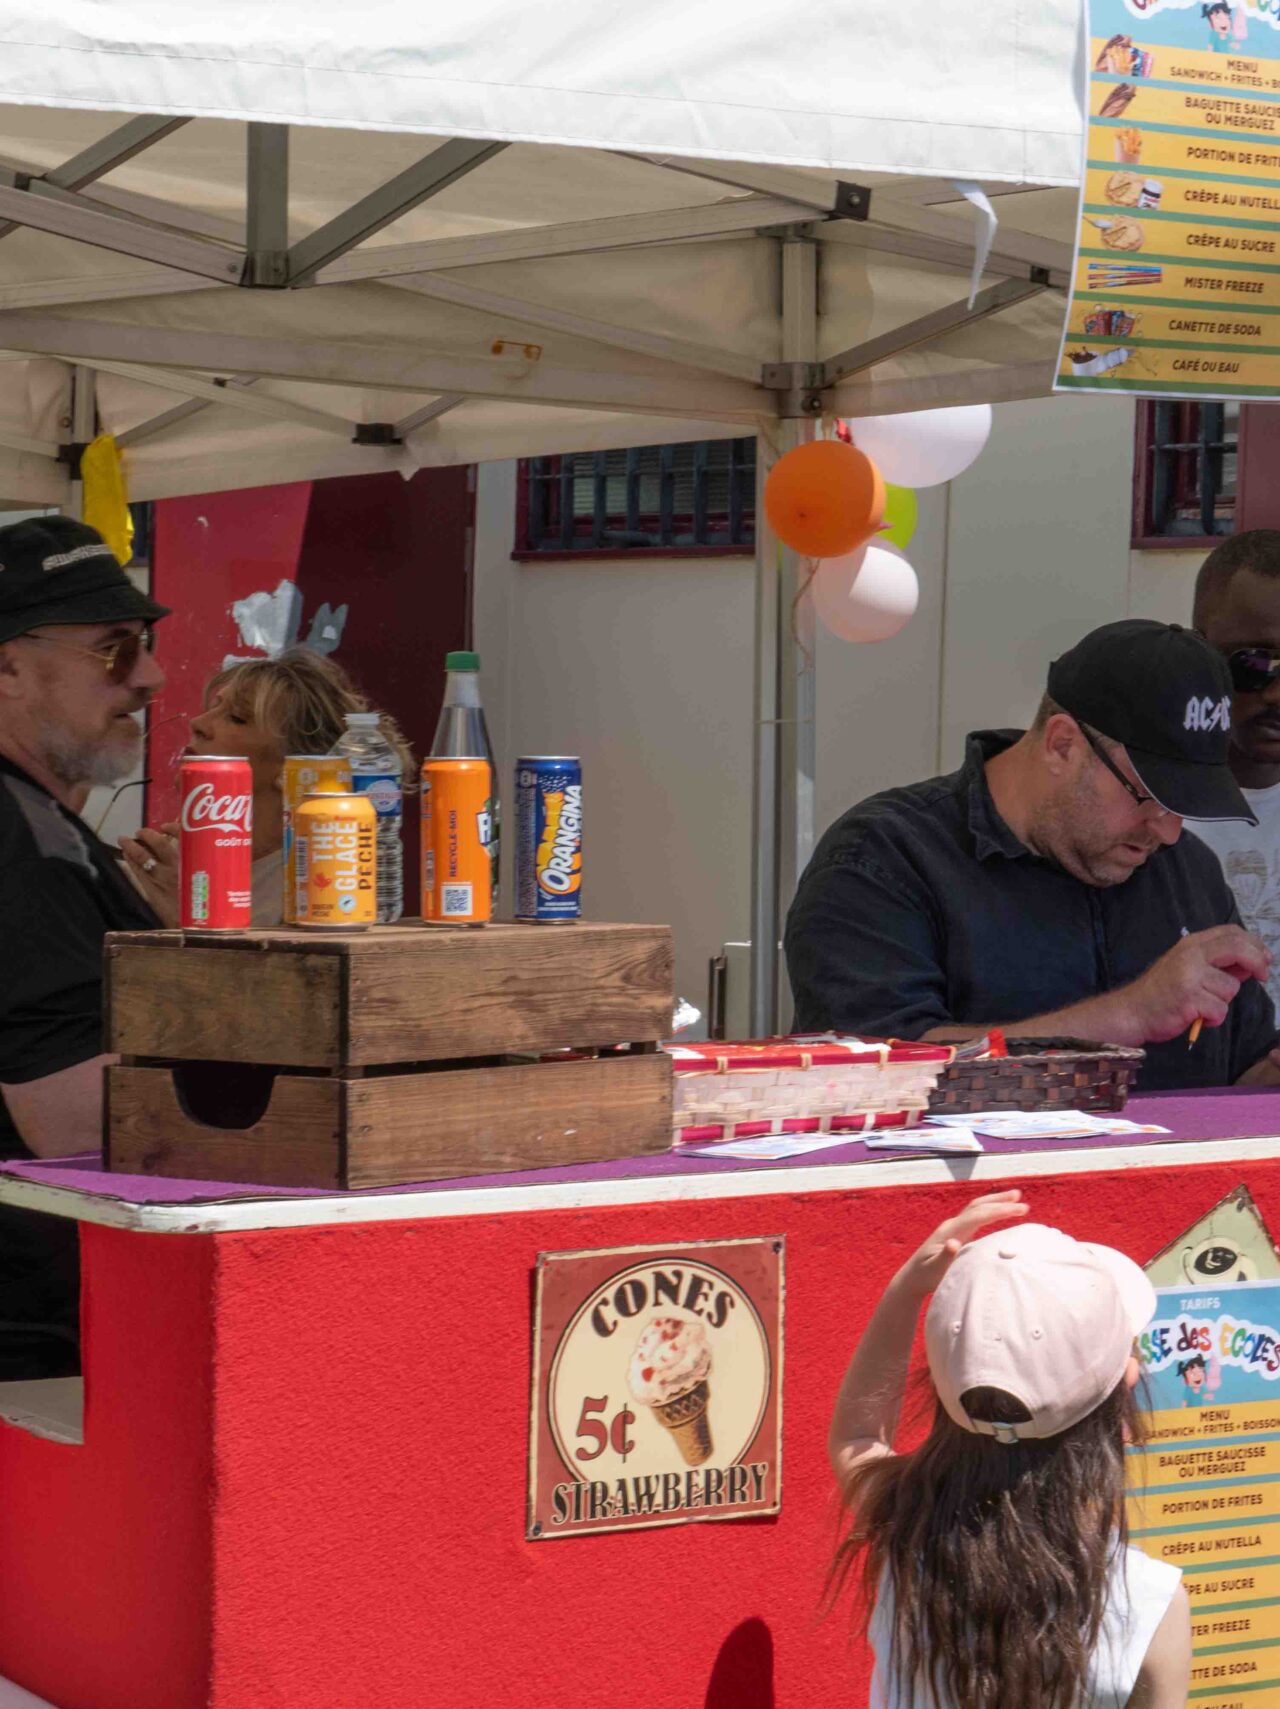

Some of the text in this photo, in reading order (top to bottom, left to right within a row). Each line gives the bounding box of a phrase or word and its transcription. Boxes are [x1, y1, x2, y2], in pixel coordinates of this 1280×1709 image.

[1227, 59, 1258, 73] MENU
[1170, 66, 1222, 81] SANDWICH
[1230, 74, 1263, 87] FRITES
[1185, 97, 1240, 114] BAGUETTE
[1205, 112, 1275, 130] OU MERGUEZ
[1187, 146, 1234, 164] PORTION
[1236, 152, 1252, 165] DE
[1222, 195, 1236, 206] AU
[1224, 238, 1238, 249] AU
[1241, 239, 1276, 253] SUCRE
[1184, 277, 1264, 293] MISTER FREEZE
[1169, 320, 1261, 336] CANETTE DE SODA
[1172, 359, 1239, 373] CAFÉ OU EAU
[541, 785, 582, 891] ORANGINA
[590, 1269, 735, 1338] CONES
[1180, 1297, 1221, 1311] TARIFS
[1177, 1322, 1212, 1352] des
[1200, 1409, 1230, 1422] MENU
[1203, 1422, 1234, 1434] FRITES
[1159, 1446, 1266, 1467] BAGUETTE SAUCISSE
[1179, 1461, 1246, 1478] OU MERGUEZ
[552, 1462, 768, 1524] STRAWBERRY
[1162, 1494, 1263, 1514] PORTION DE FRITES
[1198, 1541, 1212, 1552] AU
[1215, 1536, 1262, 1550] NUTELLA
[1204, 1582, 1217, 1593] AU
[1221, 1578, 1255, 1592] SUCRE
[1212, 1619, 1251, 1634] FREEZE
[1213, 1665, 1226, 1677] DE
[1228, 1662, 1257, 1674] SODA
